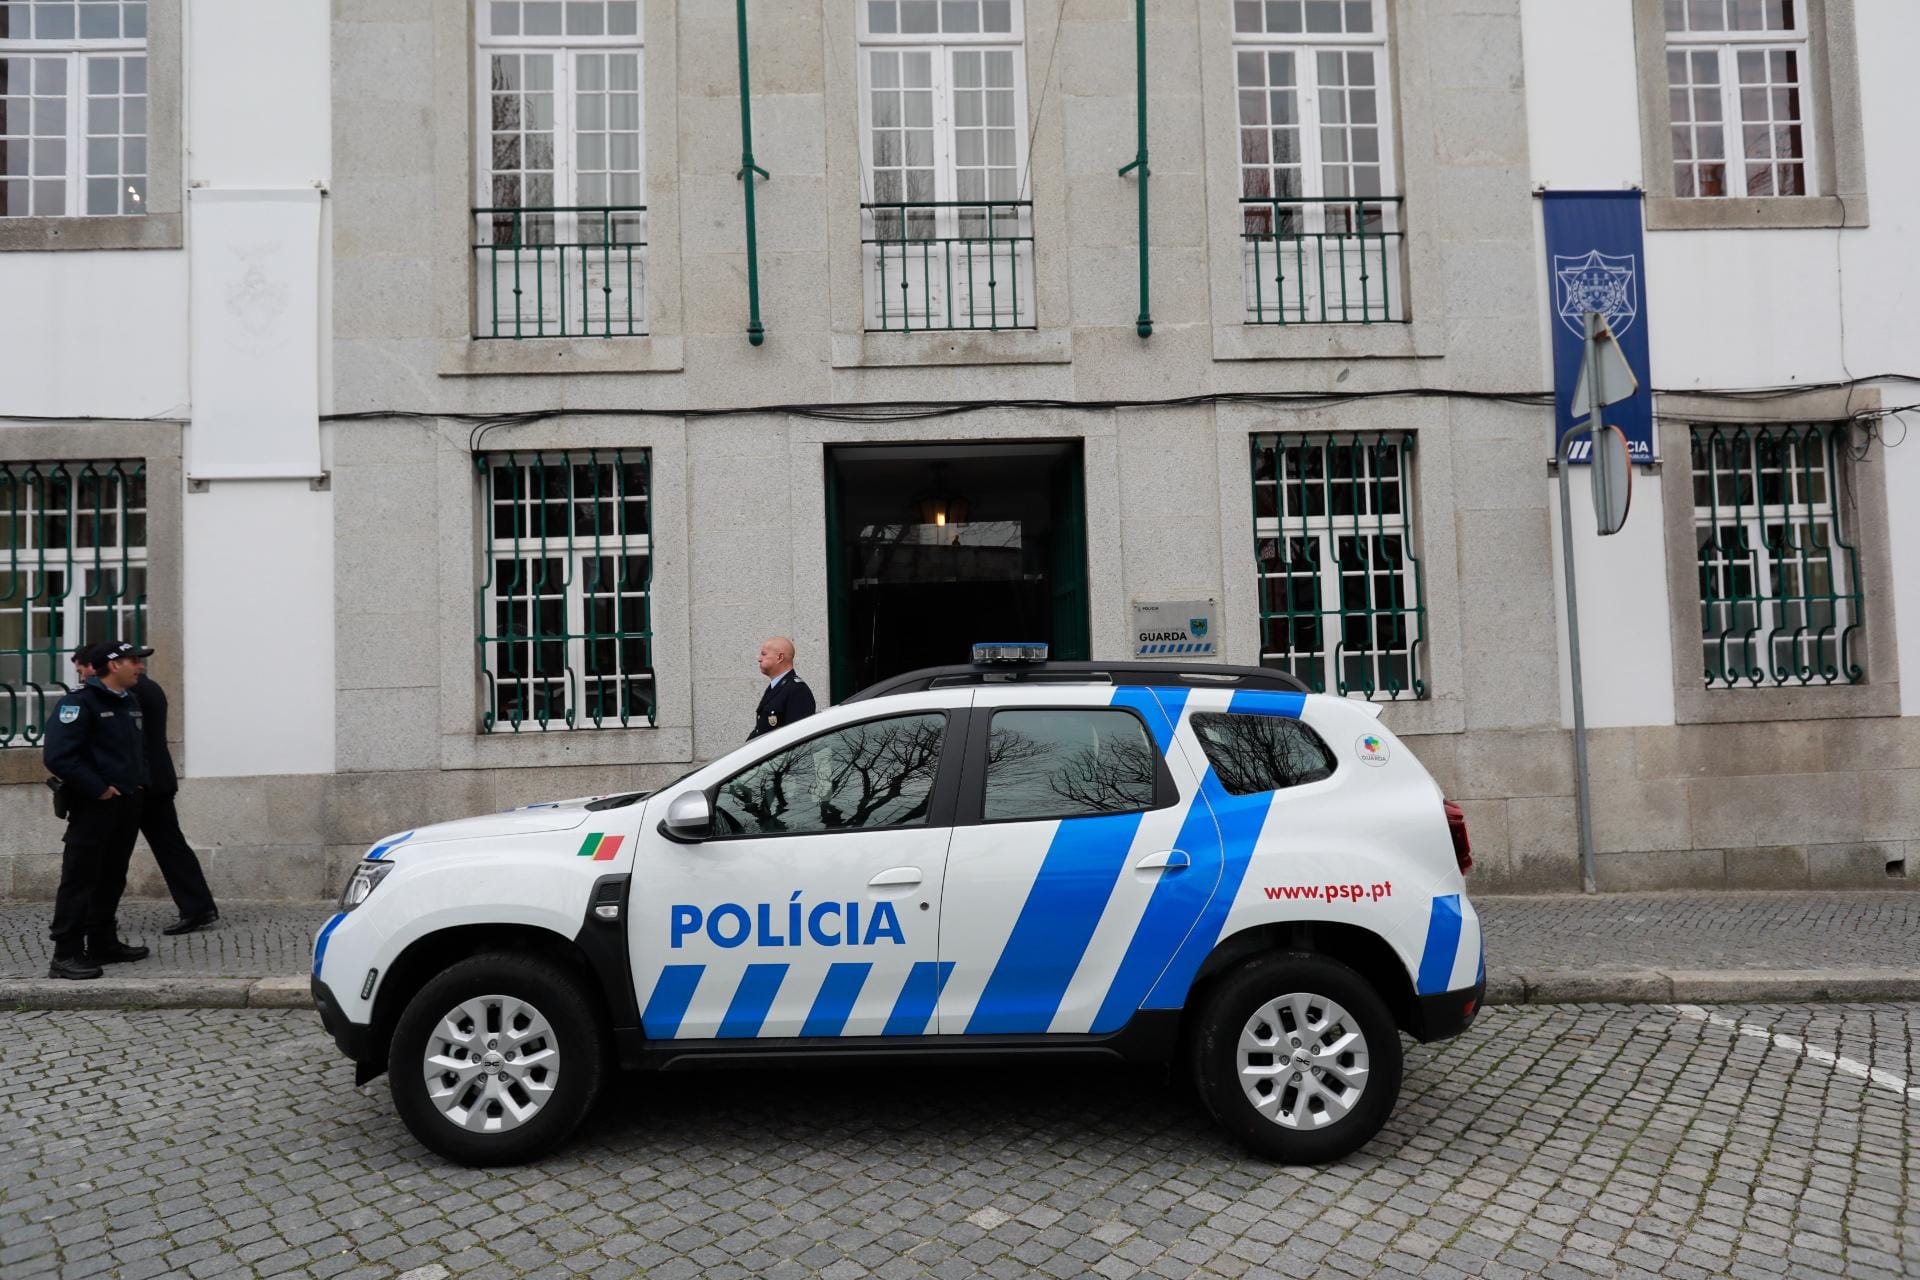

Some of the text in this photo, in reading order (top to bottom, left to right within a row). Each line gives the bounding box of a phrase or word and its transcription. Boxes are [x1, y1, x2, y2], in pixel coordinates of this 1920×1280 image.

[1139, 632, 1187, 641] GUARDA
[1264, 881, 1392, 903] www.psp.pt
[670, 890, 906, 949] POLÍCIA
